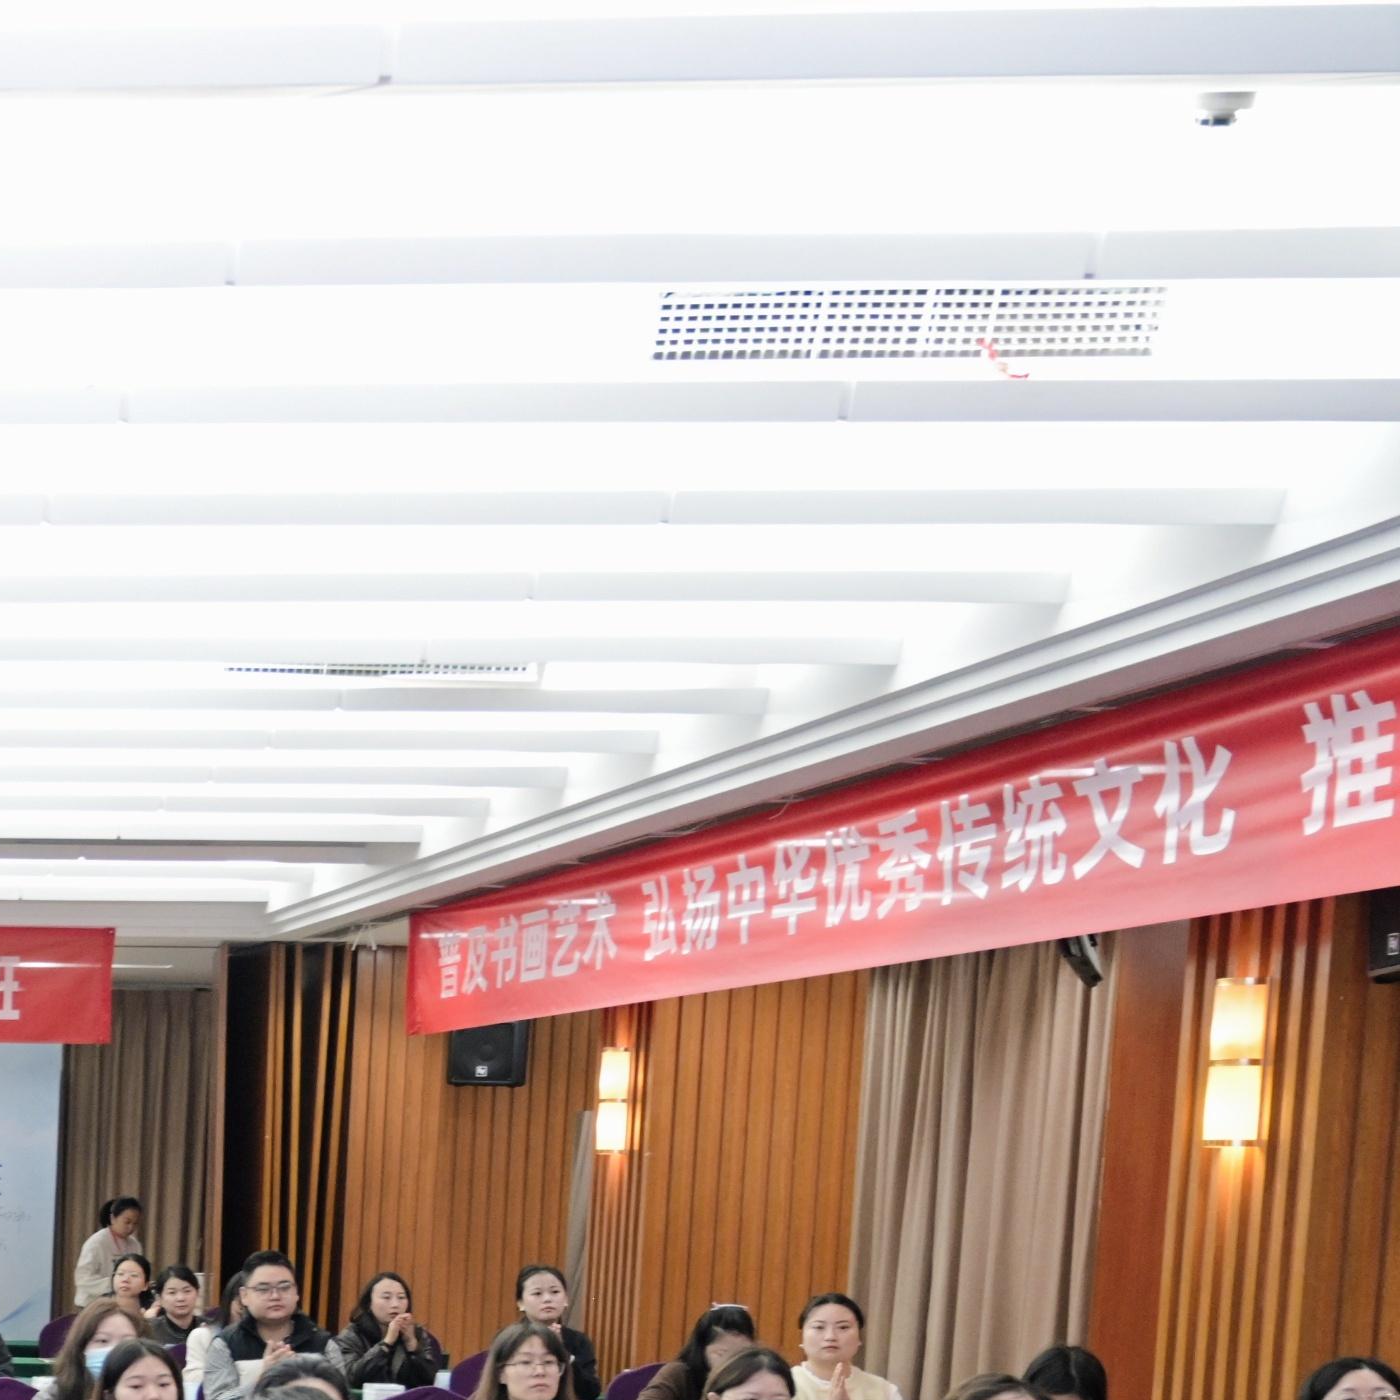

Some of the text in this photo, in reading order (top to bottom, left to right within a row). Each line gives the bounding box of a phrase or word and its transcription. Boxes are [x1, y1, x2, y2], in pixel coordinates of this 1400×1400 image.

[642, 734, 1235, 962] 弘扬中华优秀传统文化
[1299, 689, 1397, 837] 推
